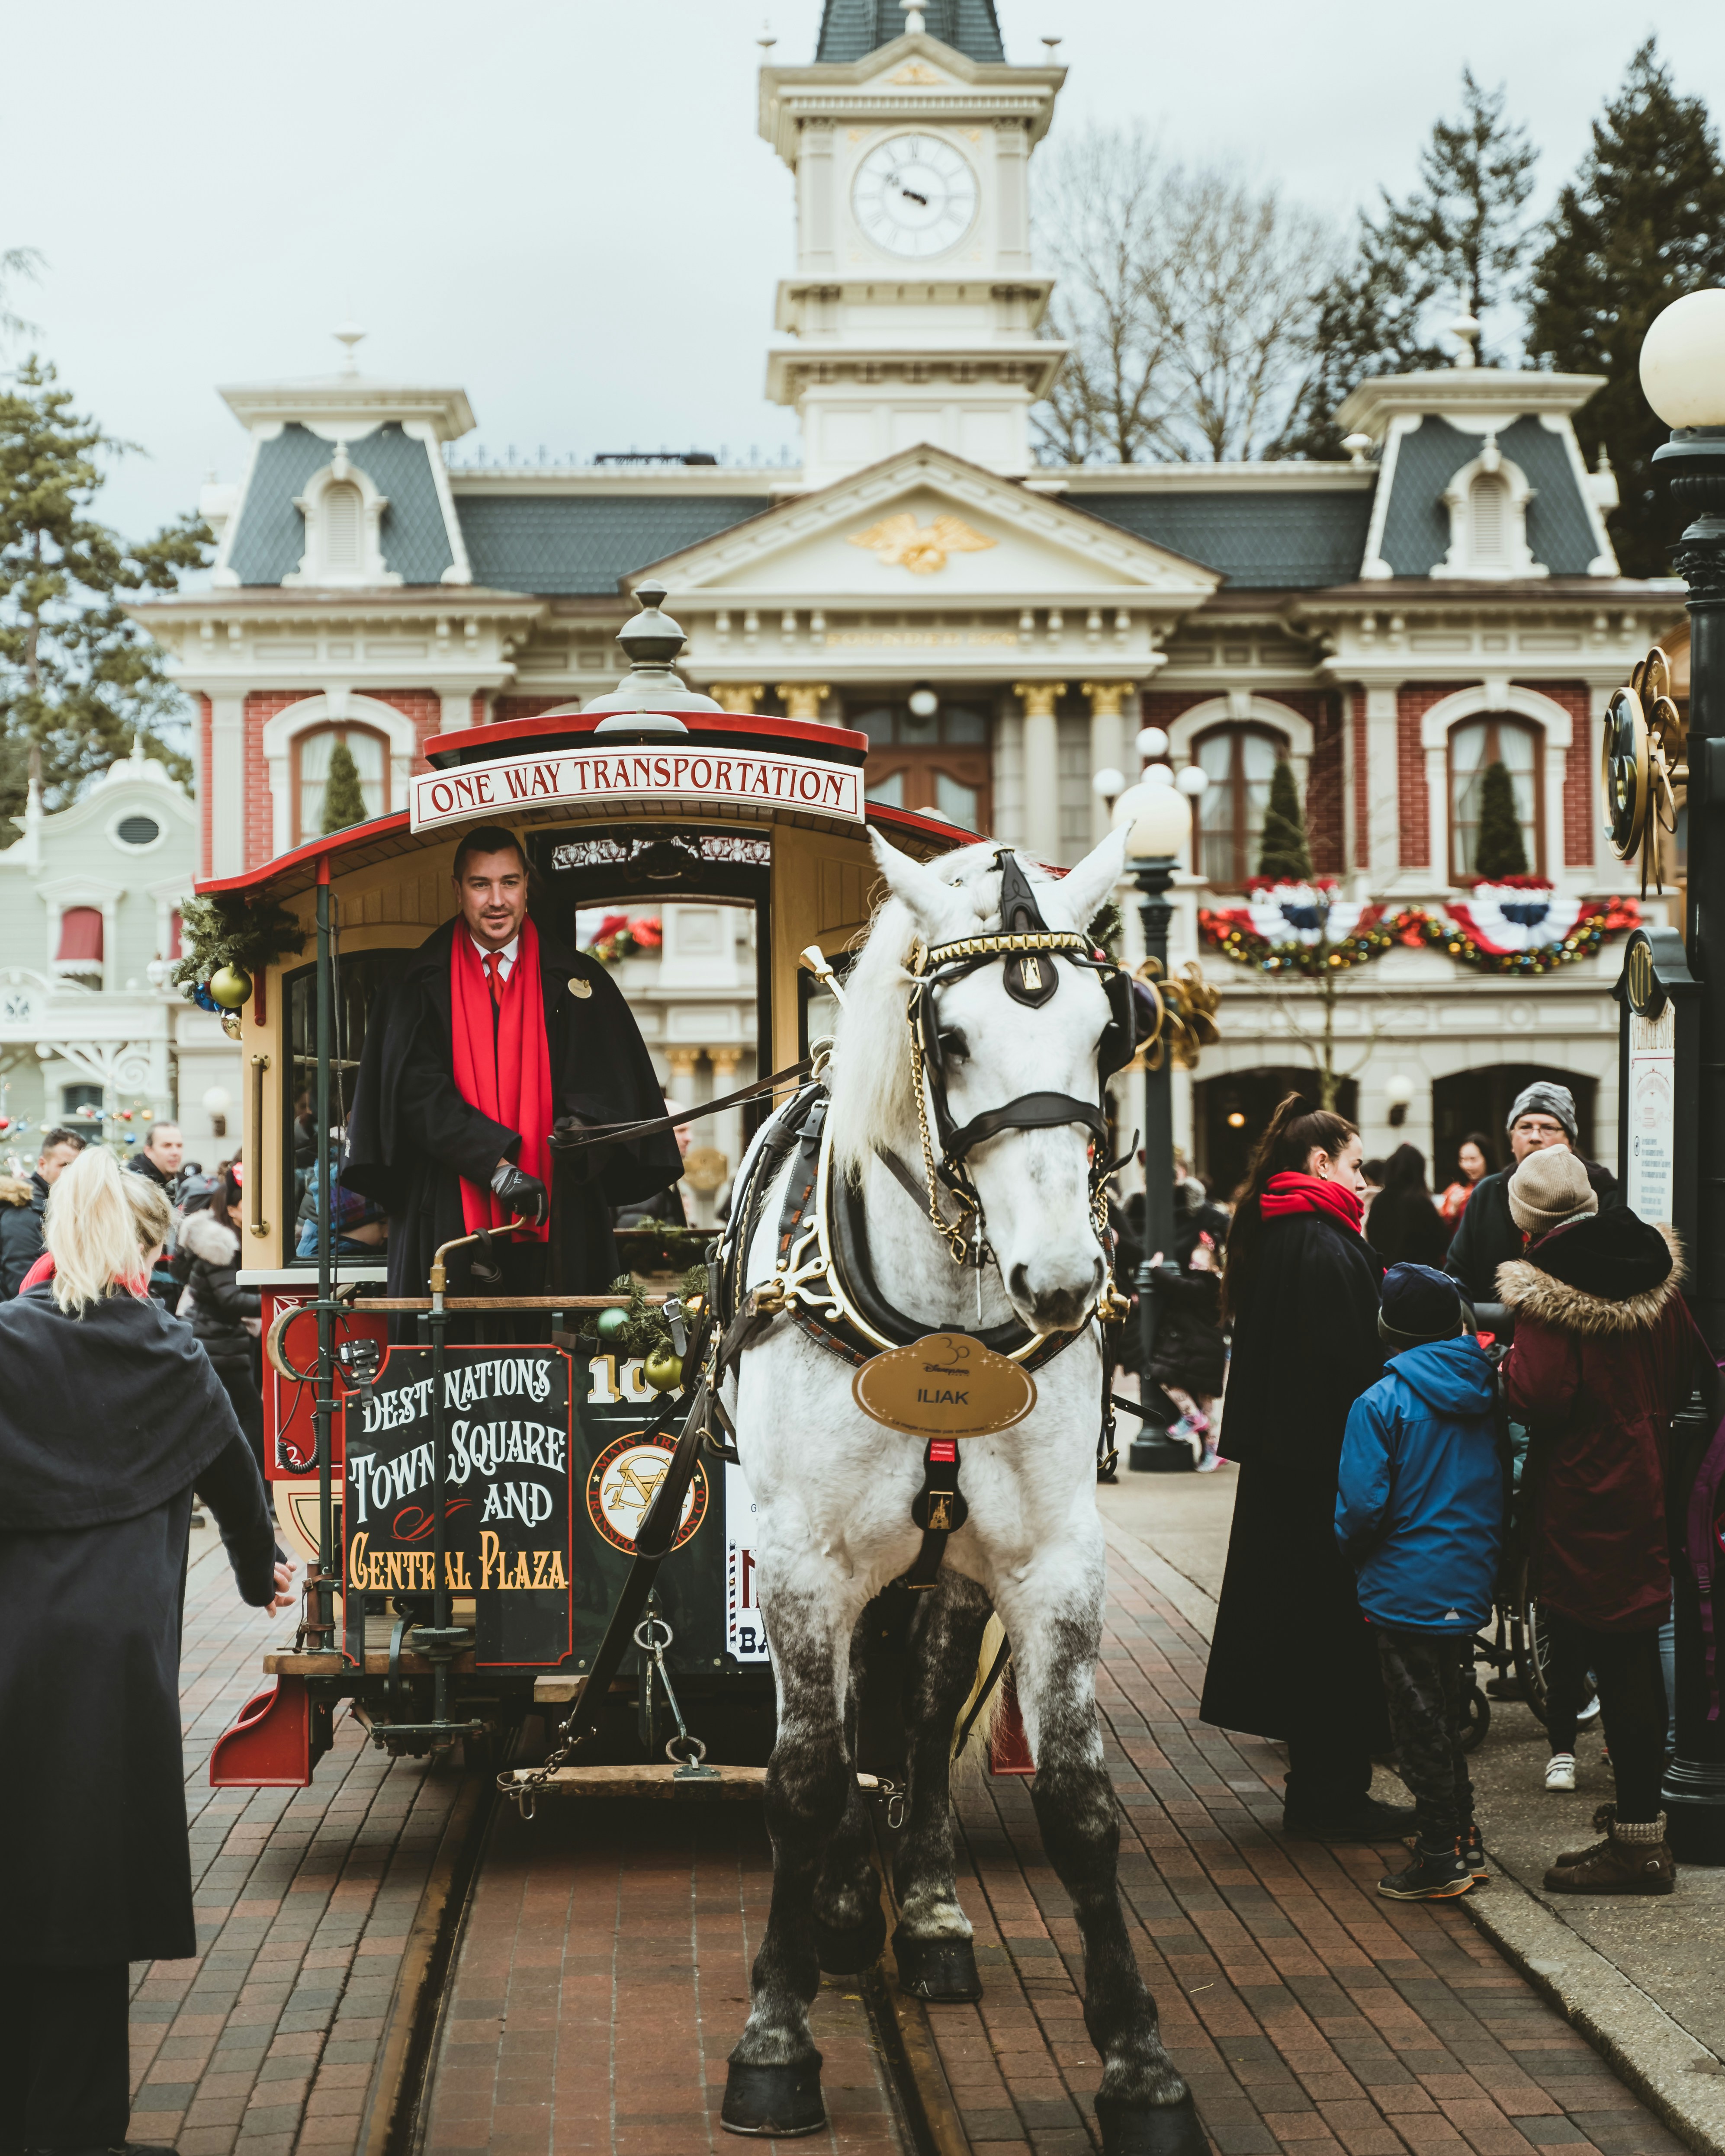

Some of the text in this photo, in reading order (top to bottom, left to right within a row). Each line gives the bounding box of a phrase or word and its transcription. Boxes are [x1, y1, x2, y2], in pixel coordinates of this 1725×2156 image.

[431, 757, 845, 812] ONE WAY TRANSPORTATION
[363, 1359, 552, 1433] DESTNATIONS
[917, 1389, 970, 1405] ILIAK
[349, 1441, 435, 1524] TOWN
[445, 1420, 566, 1484] SQUARE
[597, 1436, 636, 1471] MAIN
[480, 1482, 553, 1527] AND
[589, 1488, 698, 1552] TRANSPOION
[694, 1485, 706, 1514] CO.
[350, 1530, 569, 1591] CENTRAL PLAZA
